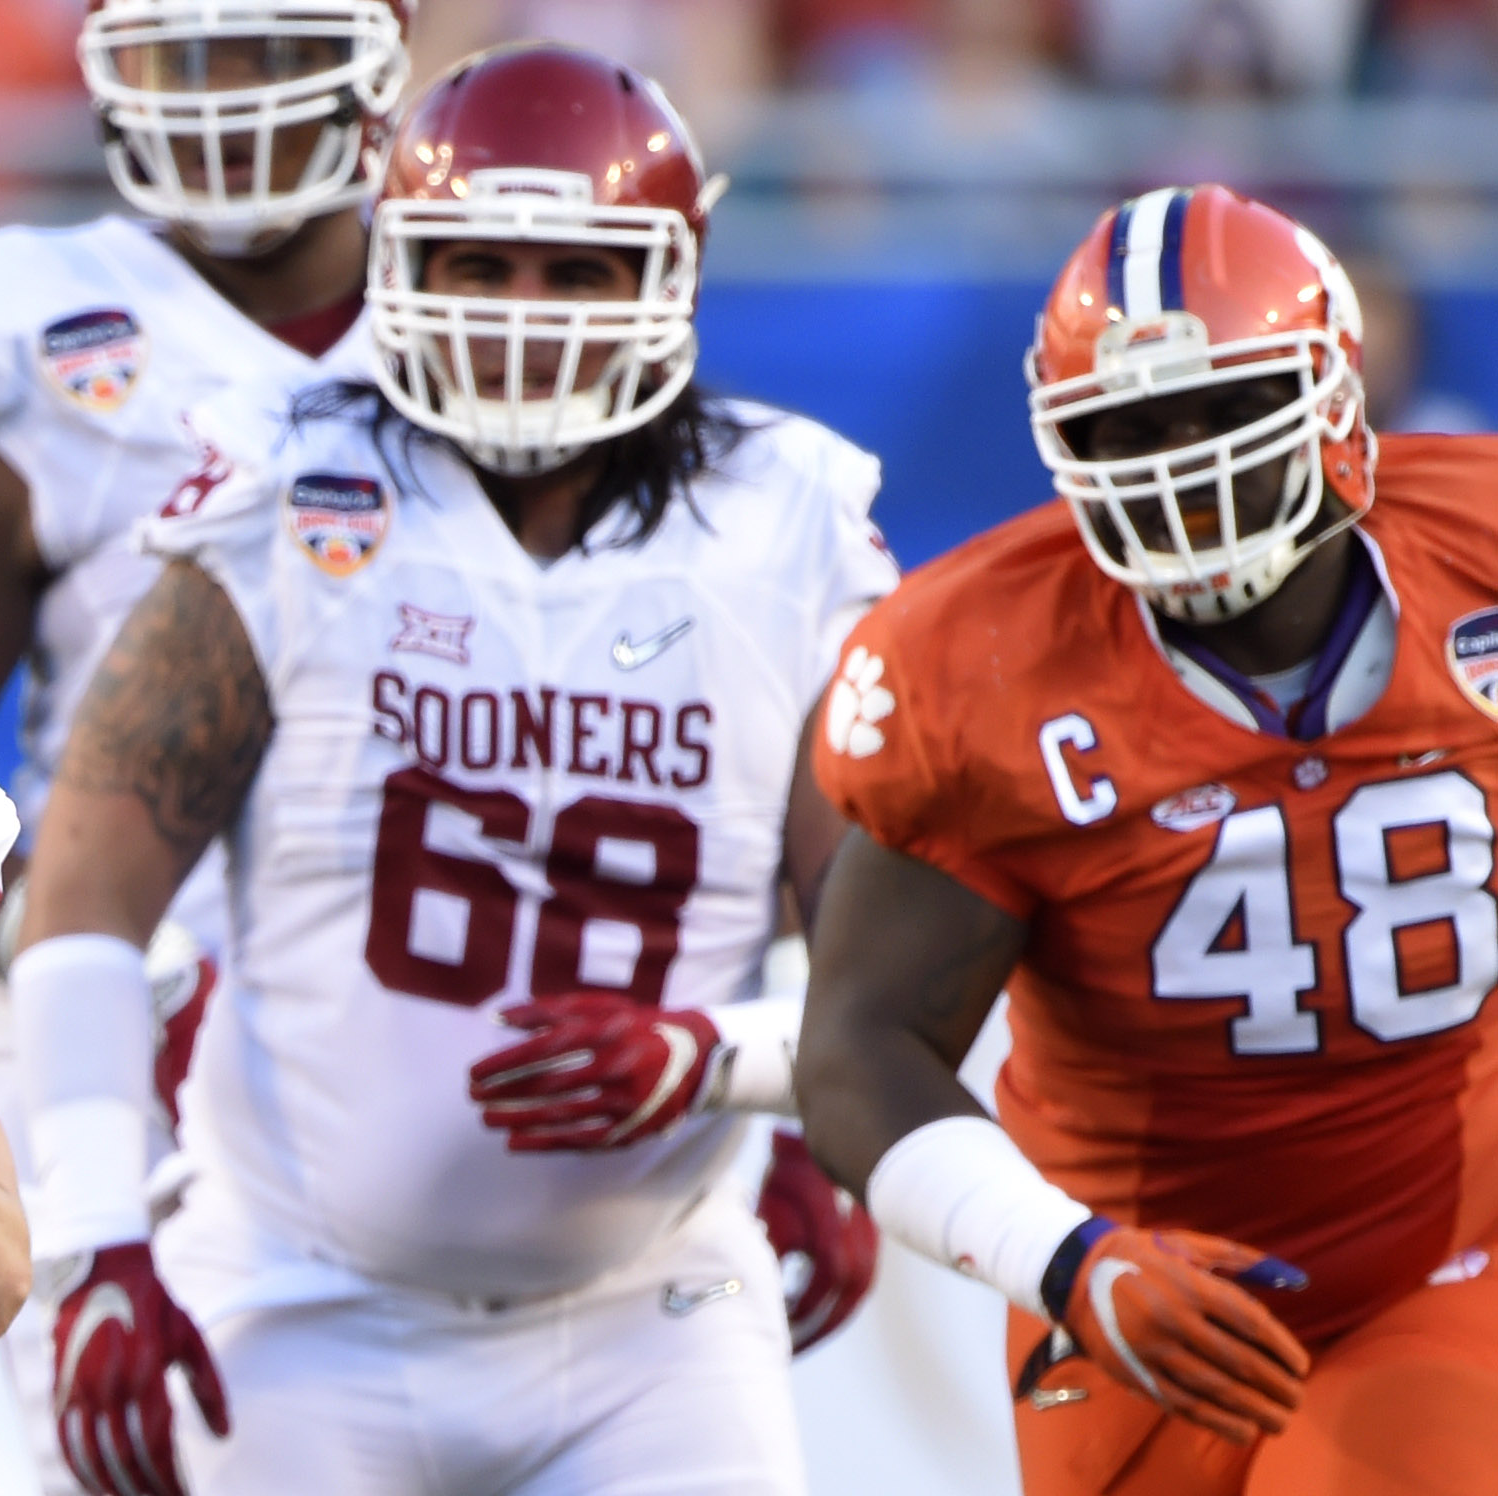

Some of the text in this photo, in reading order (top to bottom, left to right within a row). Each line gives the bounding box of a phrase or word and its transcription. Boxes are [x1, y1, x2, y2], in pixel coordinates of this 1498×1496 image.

[372, 670, 716, 788] SOONERS
[1040, 713, 1117, 826] C
[365, 765, 699, 1006] 68
[1151, 771, 1498, 1057] 48
